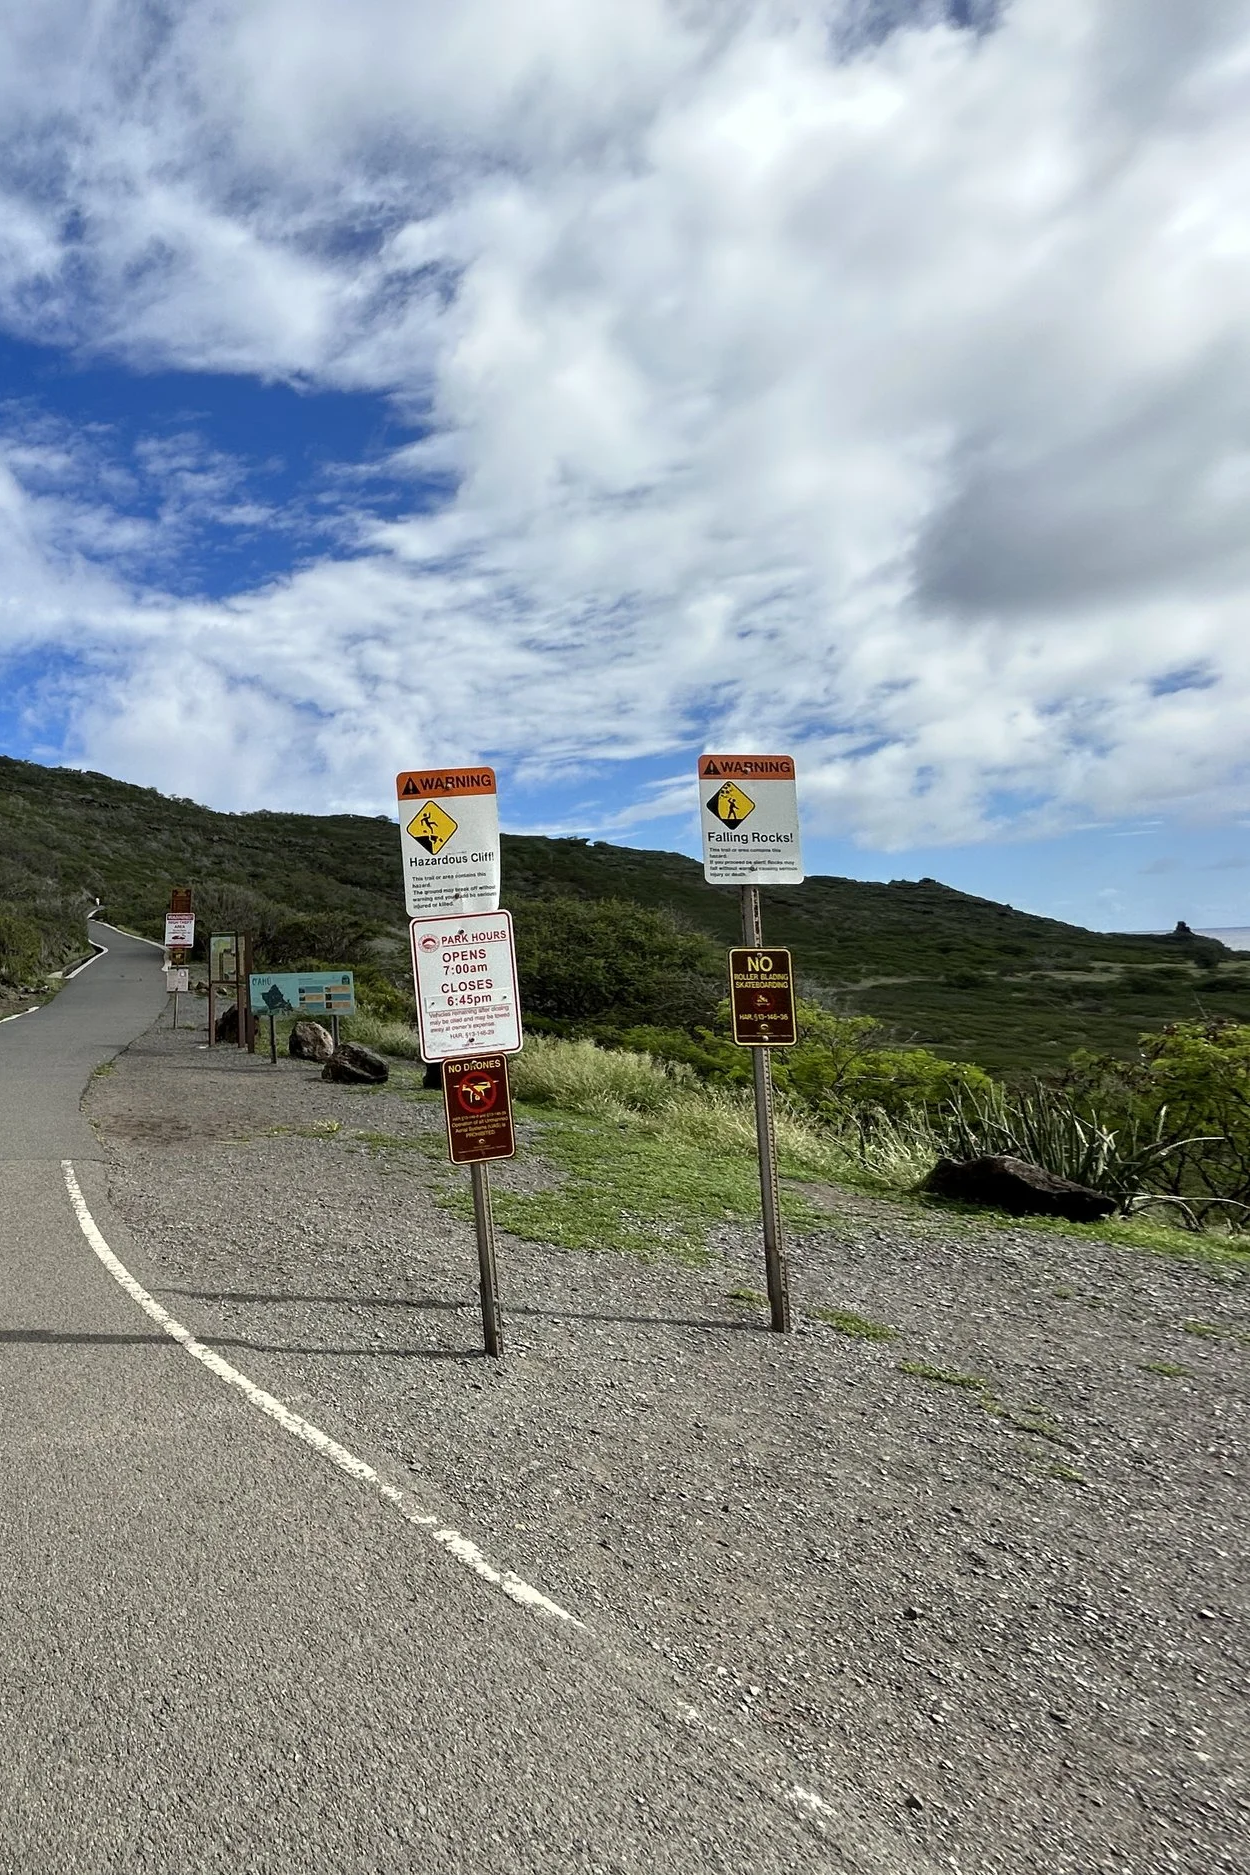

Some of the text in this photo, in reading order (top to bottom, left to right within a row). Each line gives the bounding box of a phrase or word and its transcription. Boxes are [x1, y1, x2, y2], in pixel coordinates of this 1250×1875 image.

[720, 762, 790, 773] WARNING
[420, 774, 491, 790] WARNING
[708, 832, 793, 844] Falling Rocks!
[410, 852, 494, 867] Hazardous Cliff!
[441, 934, 468, 944] PARK
[471, 930, 507, 941] HOURS
[442, 949, 486, 963] OPENS
[443, 963, 488, 975] 7:00am
[747, 956, 773, 972] NO
[441, 979, 493, 993] CLOSES
[447, 994, 492, 1006] 6:45pm
[448, 1059, 501, 1073] NO DRONES
